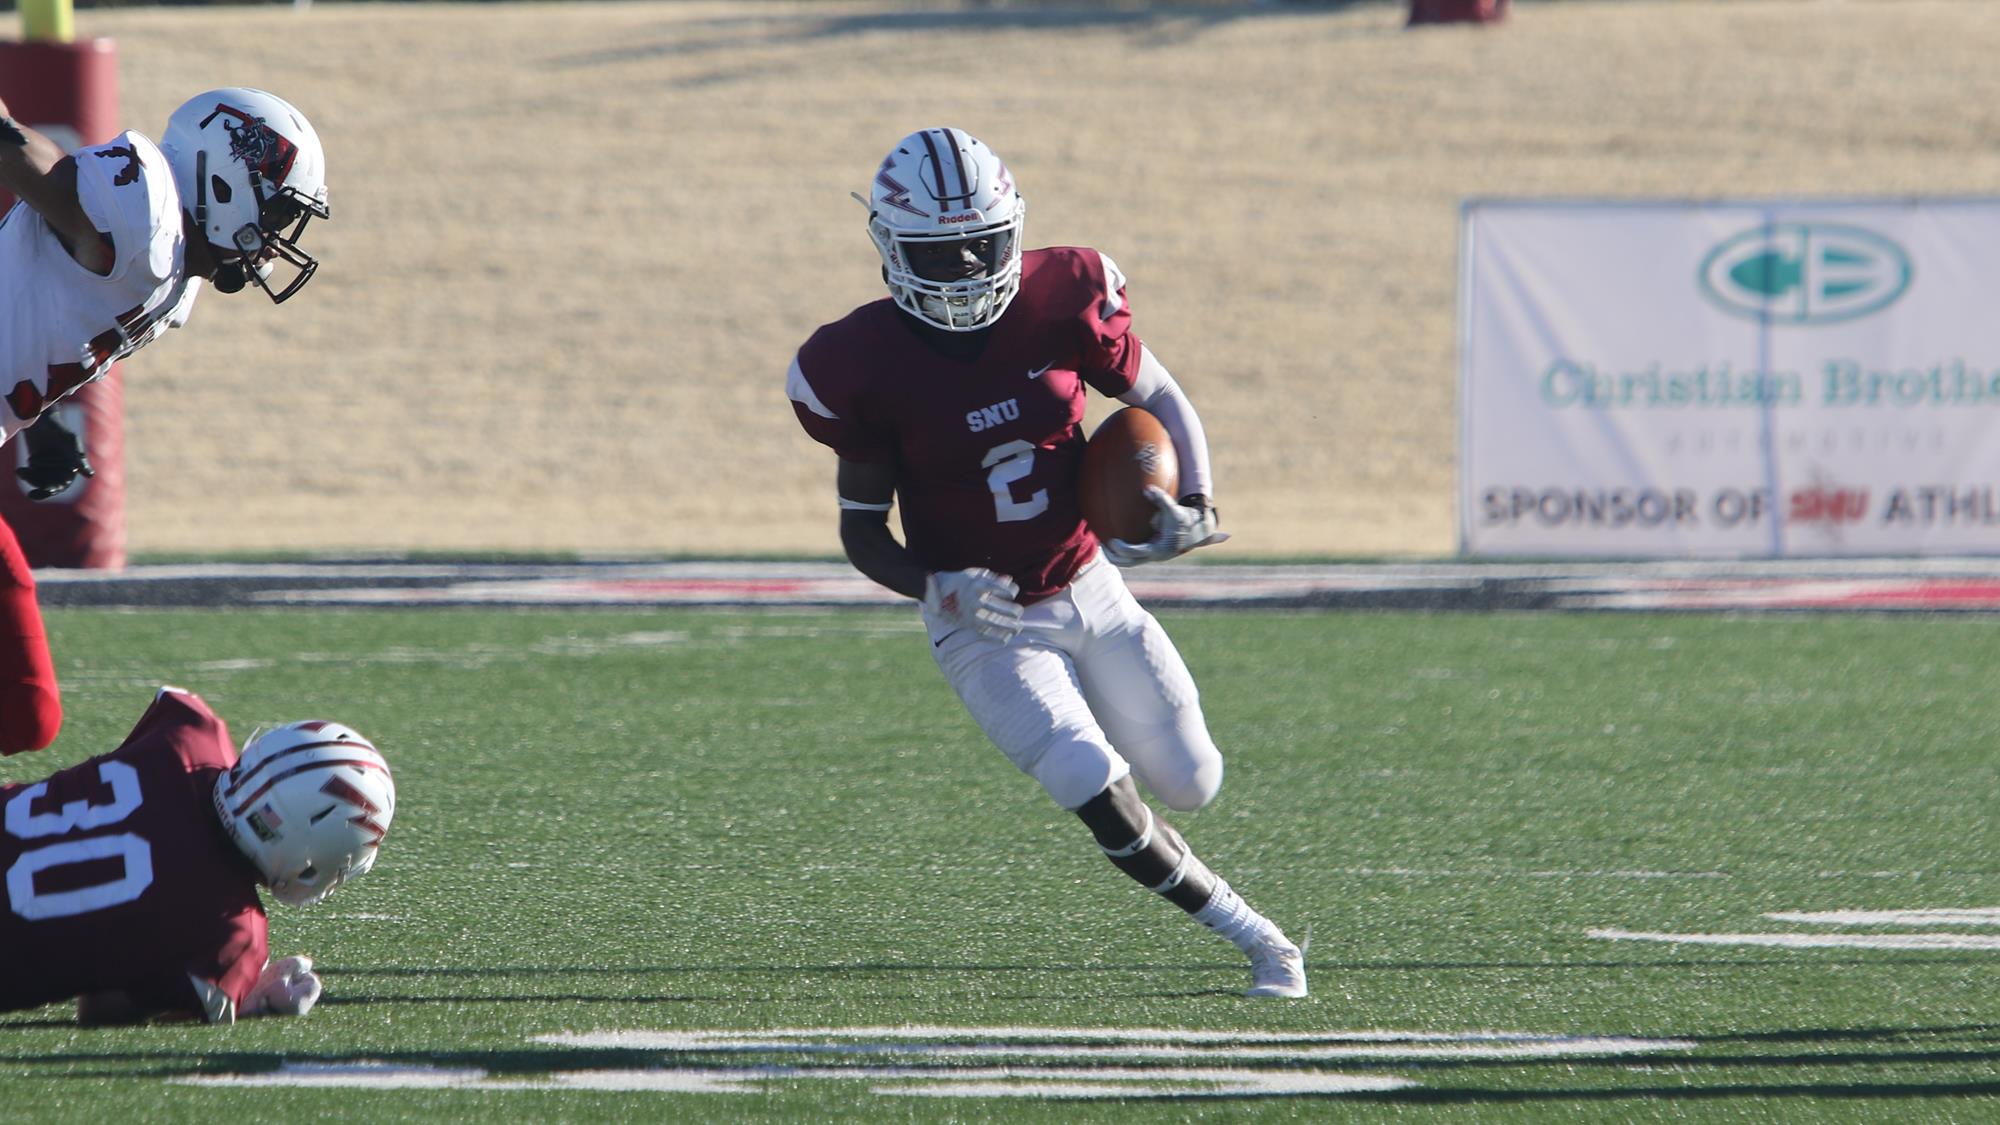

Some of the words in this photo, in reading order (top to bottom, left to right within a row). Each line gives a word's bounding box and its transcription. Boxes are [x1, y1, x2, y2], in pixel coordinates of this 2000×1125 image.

[938, 213, 979, 225] Riddell
[1542, 360, 1801, 407] Christian
[966, 399, 1020, 432] SNU
[981, 439, 1049, 523] 2
[1484, 487, 1697, 527] SPONSOR
[1714, 488, 1774, 527] OF
[5, 760, 154, 921] 30
